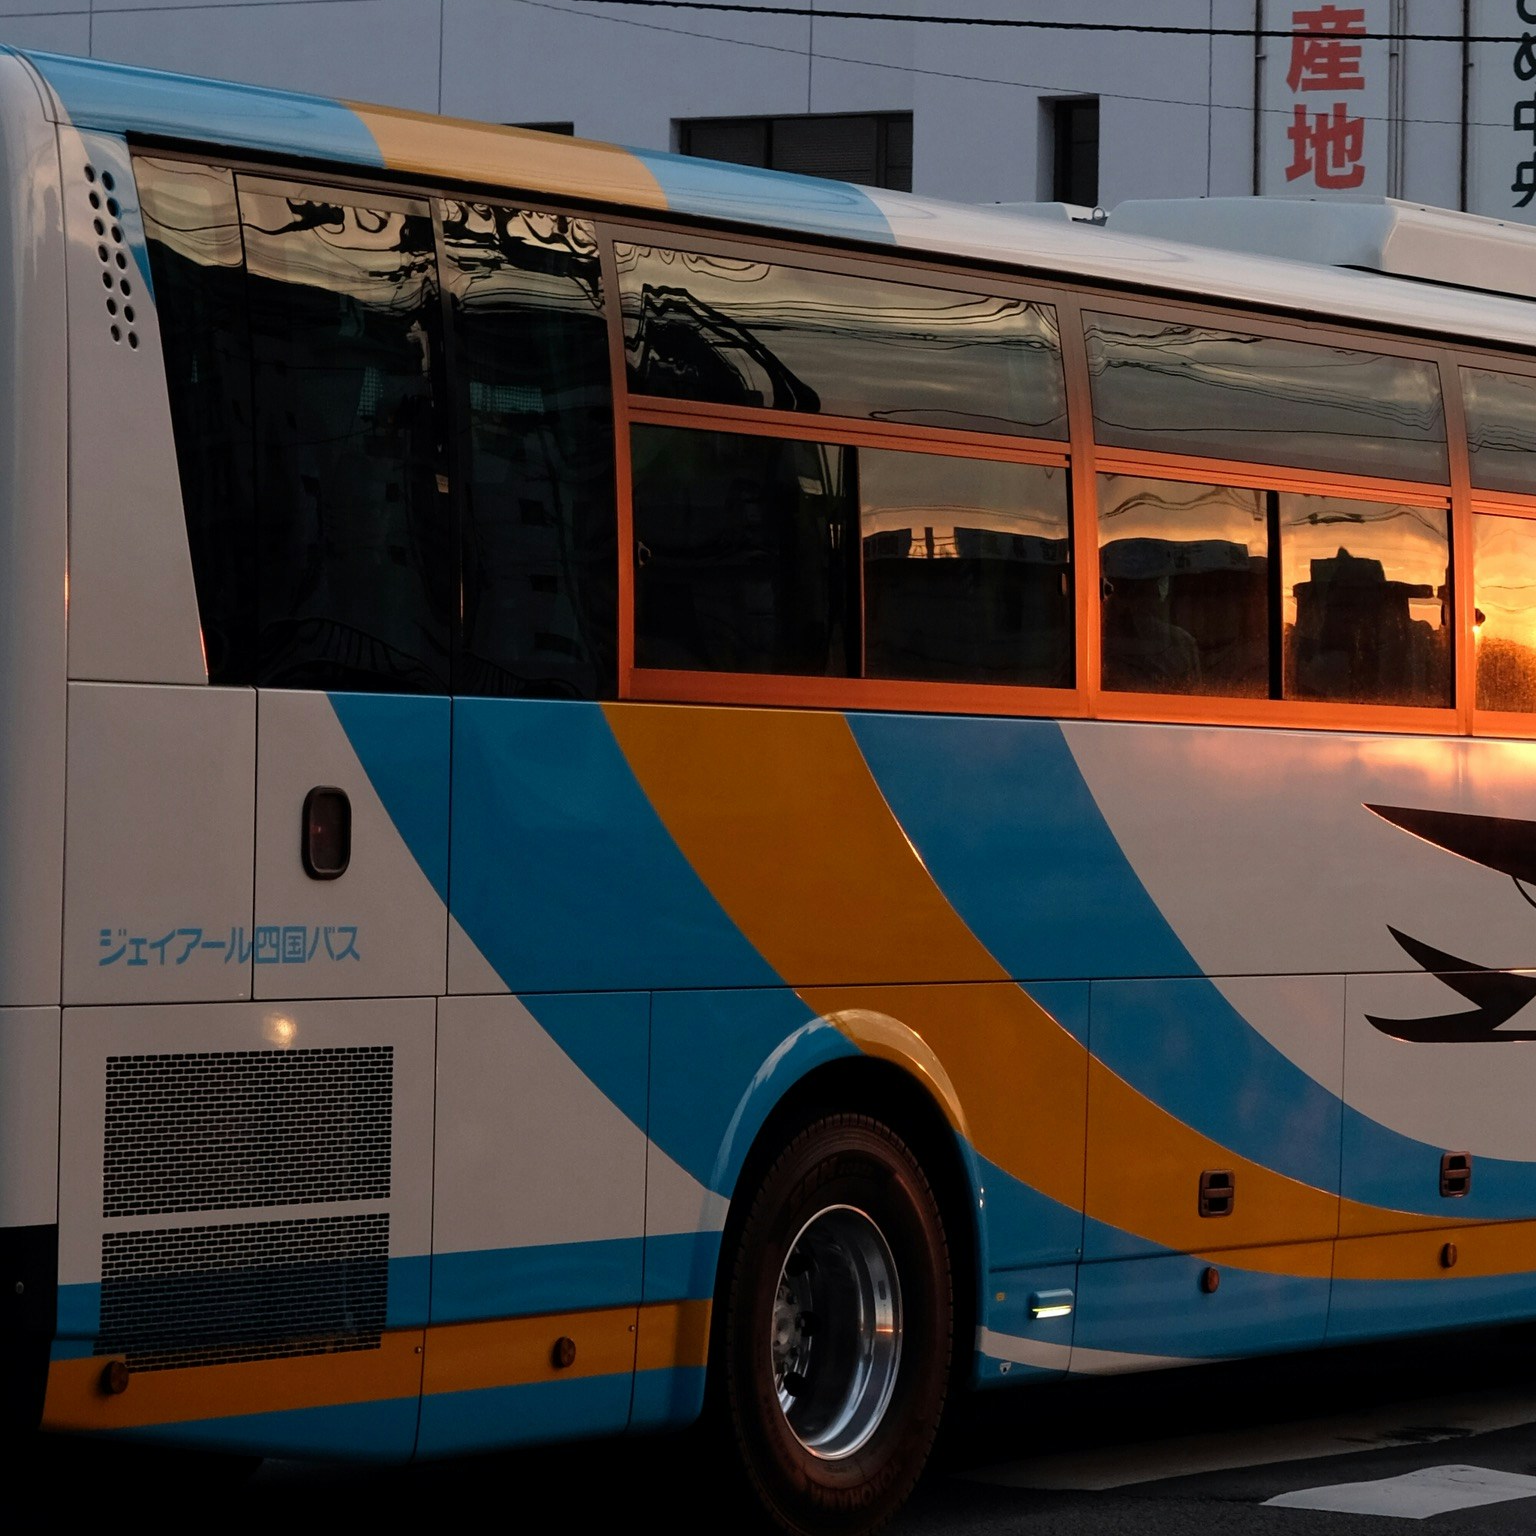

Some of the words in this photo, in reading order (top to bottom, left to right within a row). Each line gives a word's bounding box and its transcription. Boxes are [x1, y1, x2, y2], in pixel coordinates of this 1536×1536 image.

[98, 926, 361, 966] ジェイアール四国バス
